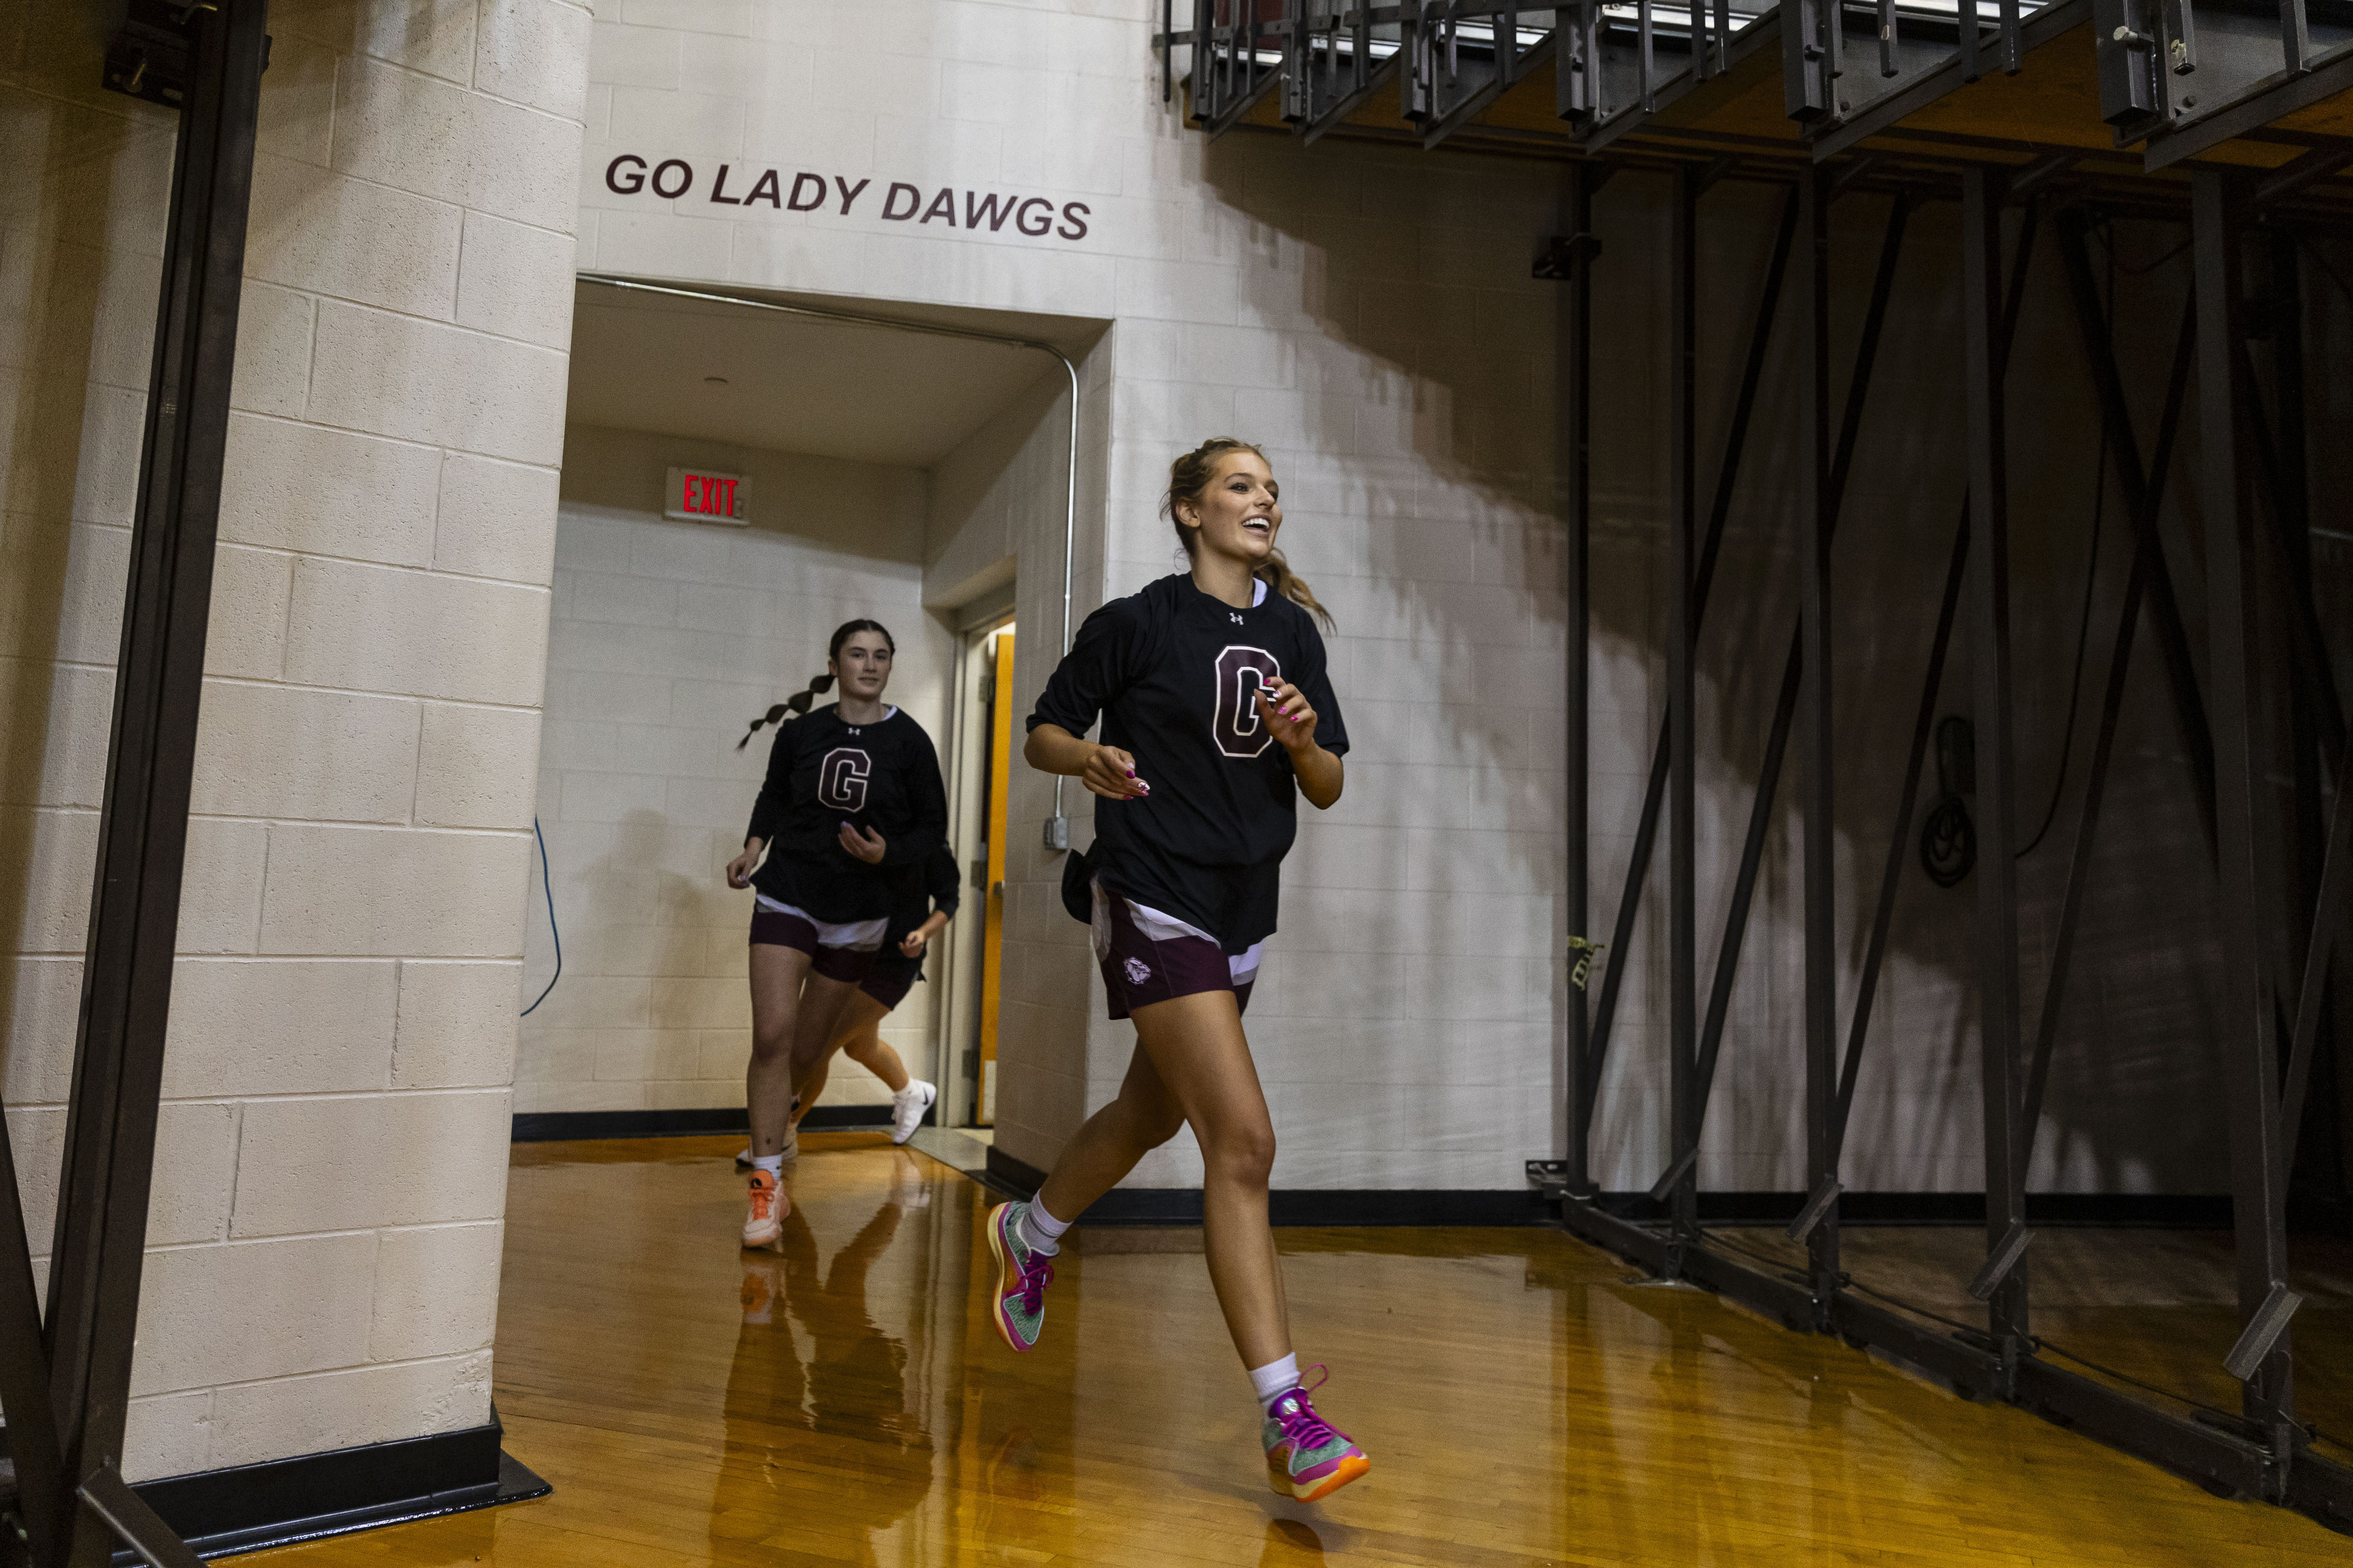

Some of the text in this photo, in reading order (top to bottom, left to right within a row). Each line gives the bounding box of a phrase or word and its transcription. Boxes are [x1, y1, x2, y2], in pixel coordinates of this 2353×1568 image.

[605, 154, 1091, 240] GO LADY DAWGS
[683, 474, 739, 517] EXIT
[1213, 645, 1281, 758] G
[818, 747, 872, 813] G
